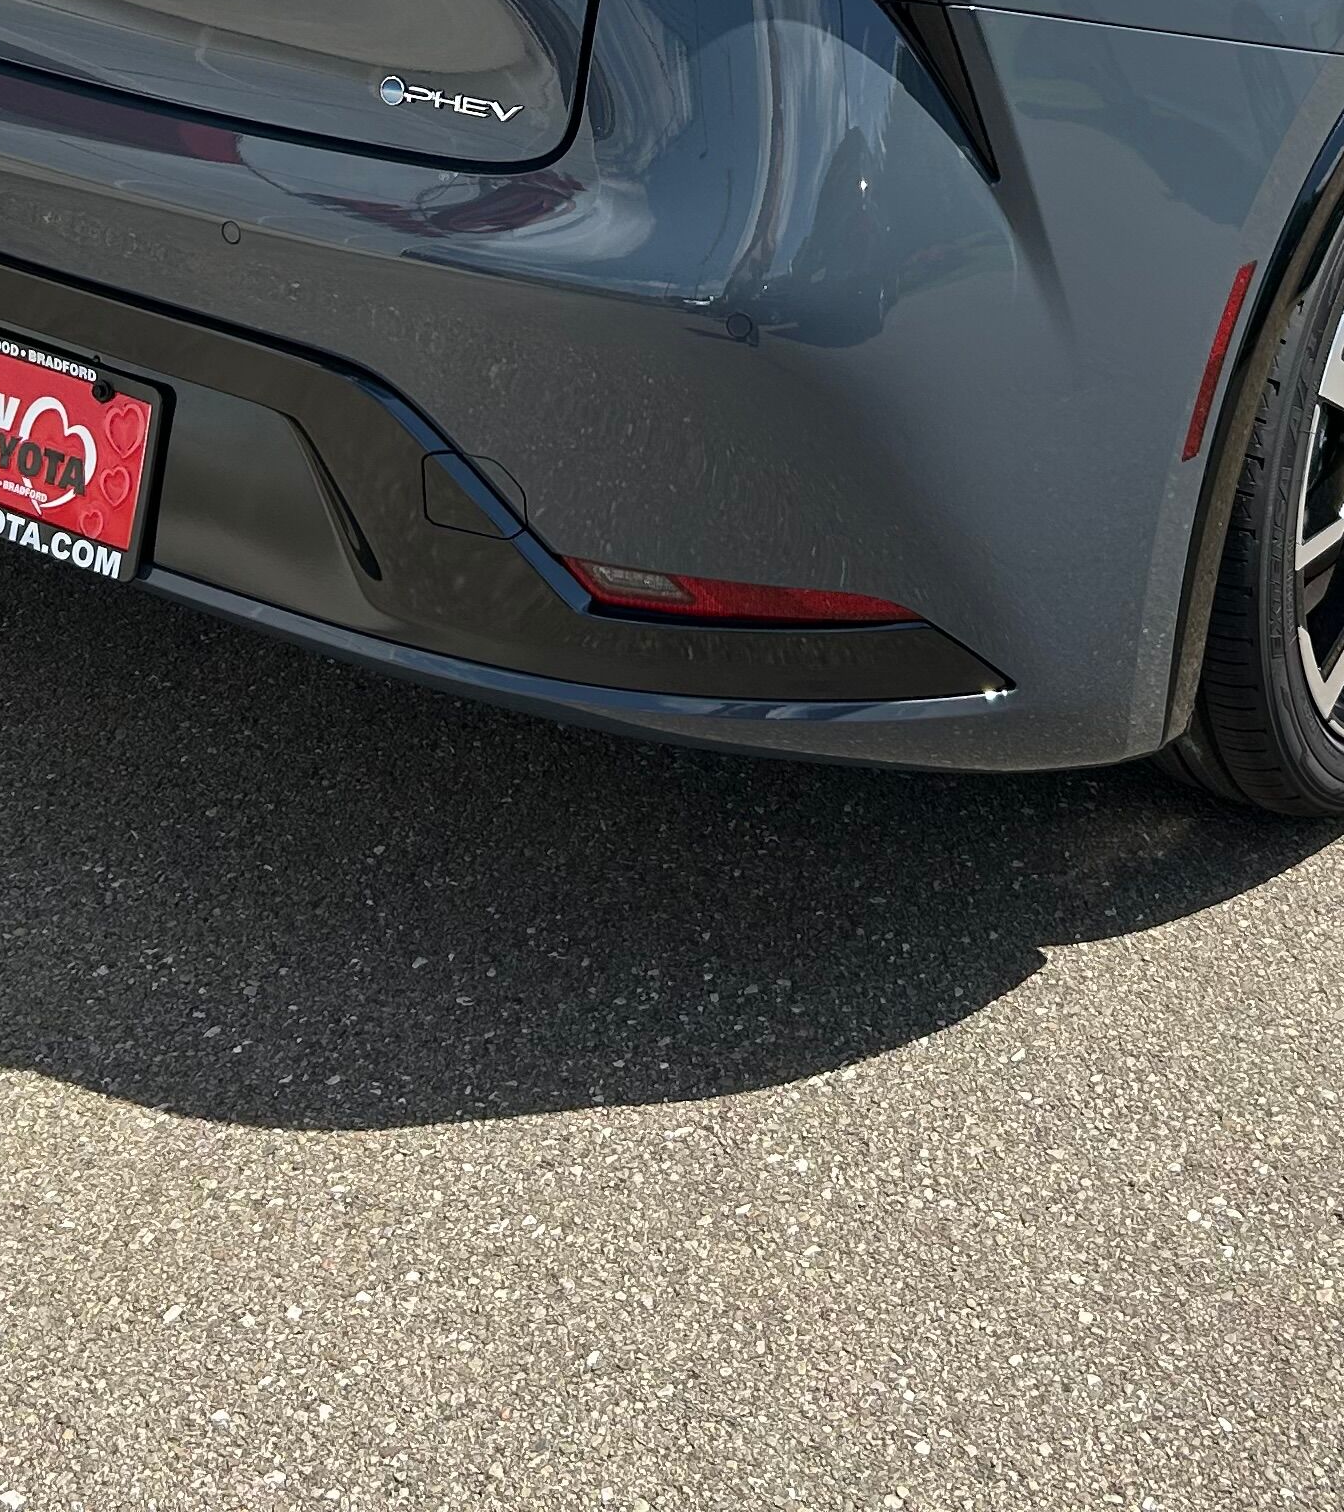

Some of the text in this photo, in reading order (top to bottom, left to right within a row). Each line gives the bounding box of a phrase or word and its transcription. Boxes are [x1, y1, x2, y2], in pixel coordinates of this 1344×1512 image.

[404, 85, 525, 123] PHEV
[28, 349, 97, 382] BRADFORD
[2, 480, 48, 503] BRADFORD
